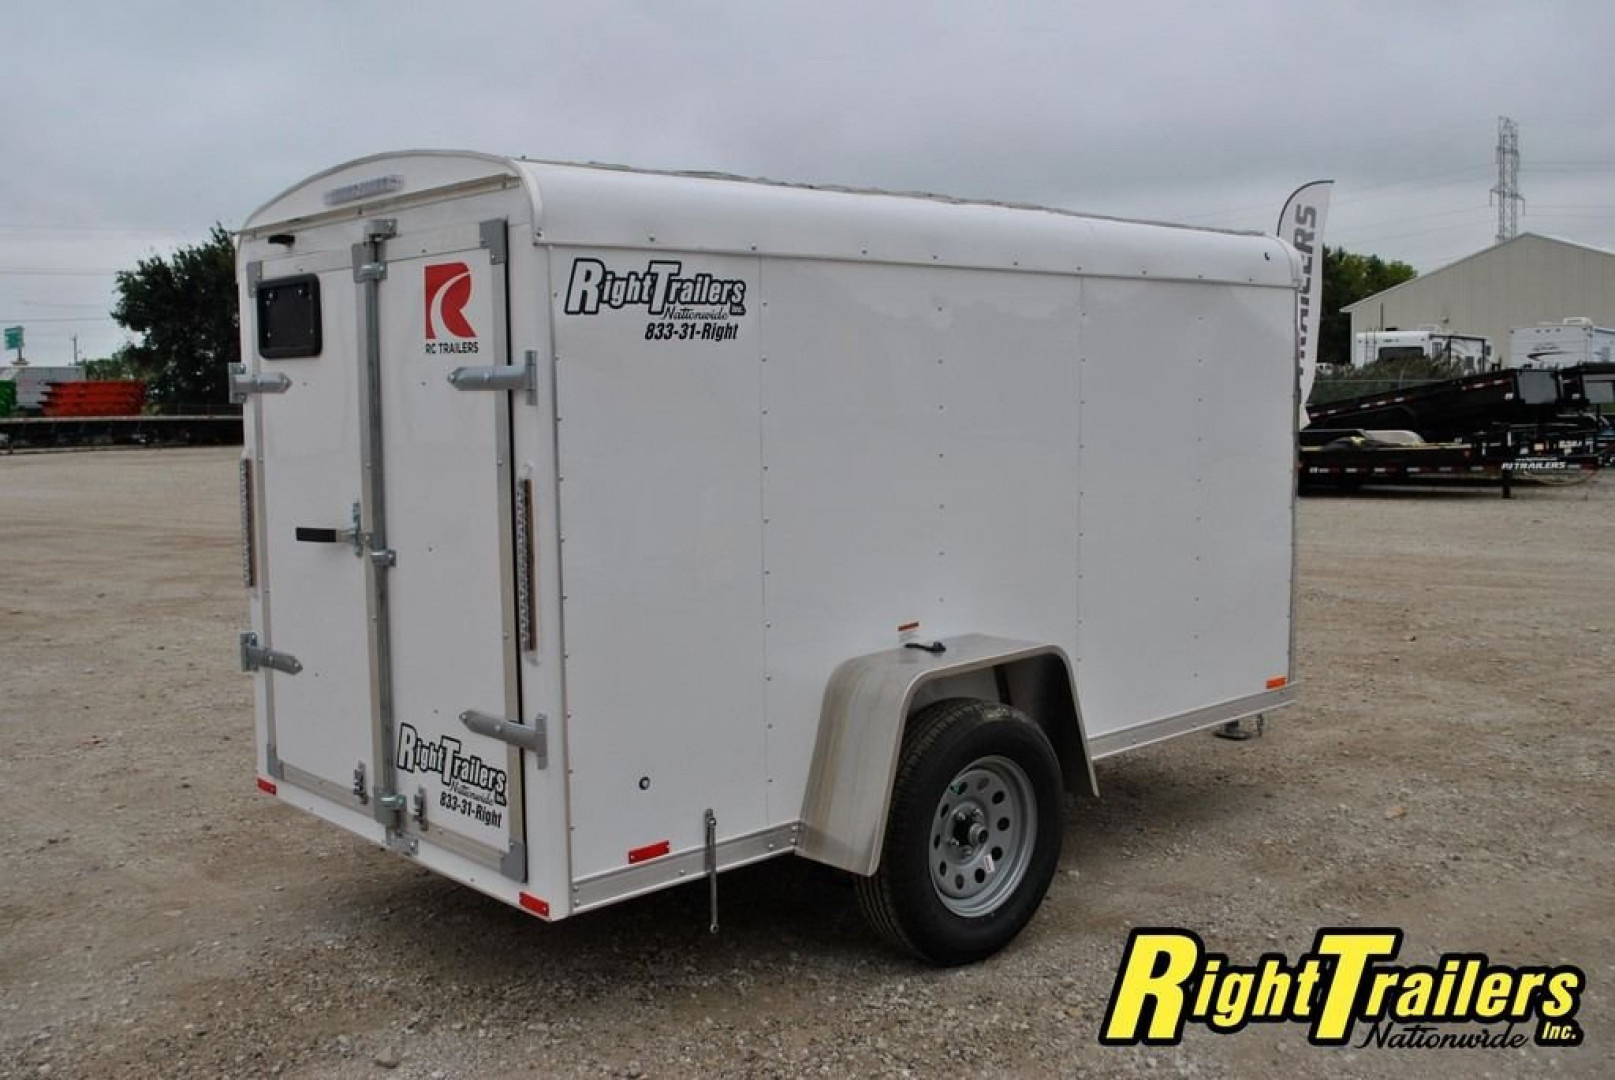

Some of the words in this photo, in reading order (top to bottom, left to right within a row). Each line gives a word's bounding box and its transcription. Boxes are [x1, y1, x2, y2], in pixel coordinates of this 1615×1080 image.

[644, 322, 739, 342] 833-31-Right
[425, 343, 437, 354] RC
[438, 341, 479, 354] TRAILERS
[439, 791, 503, 829] 833-31-Right
